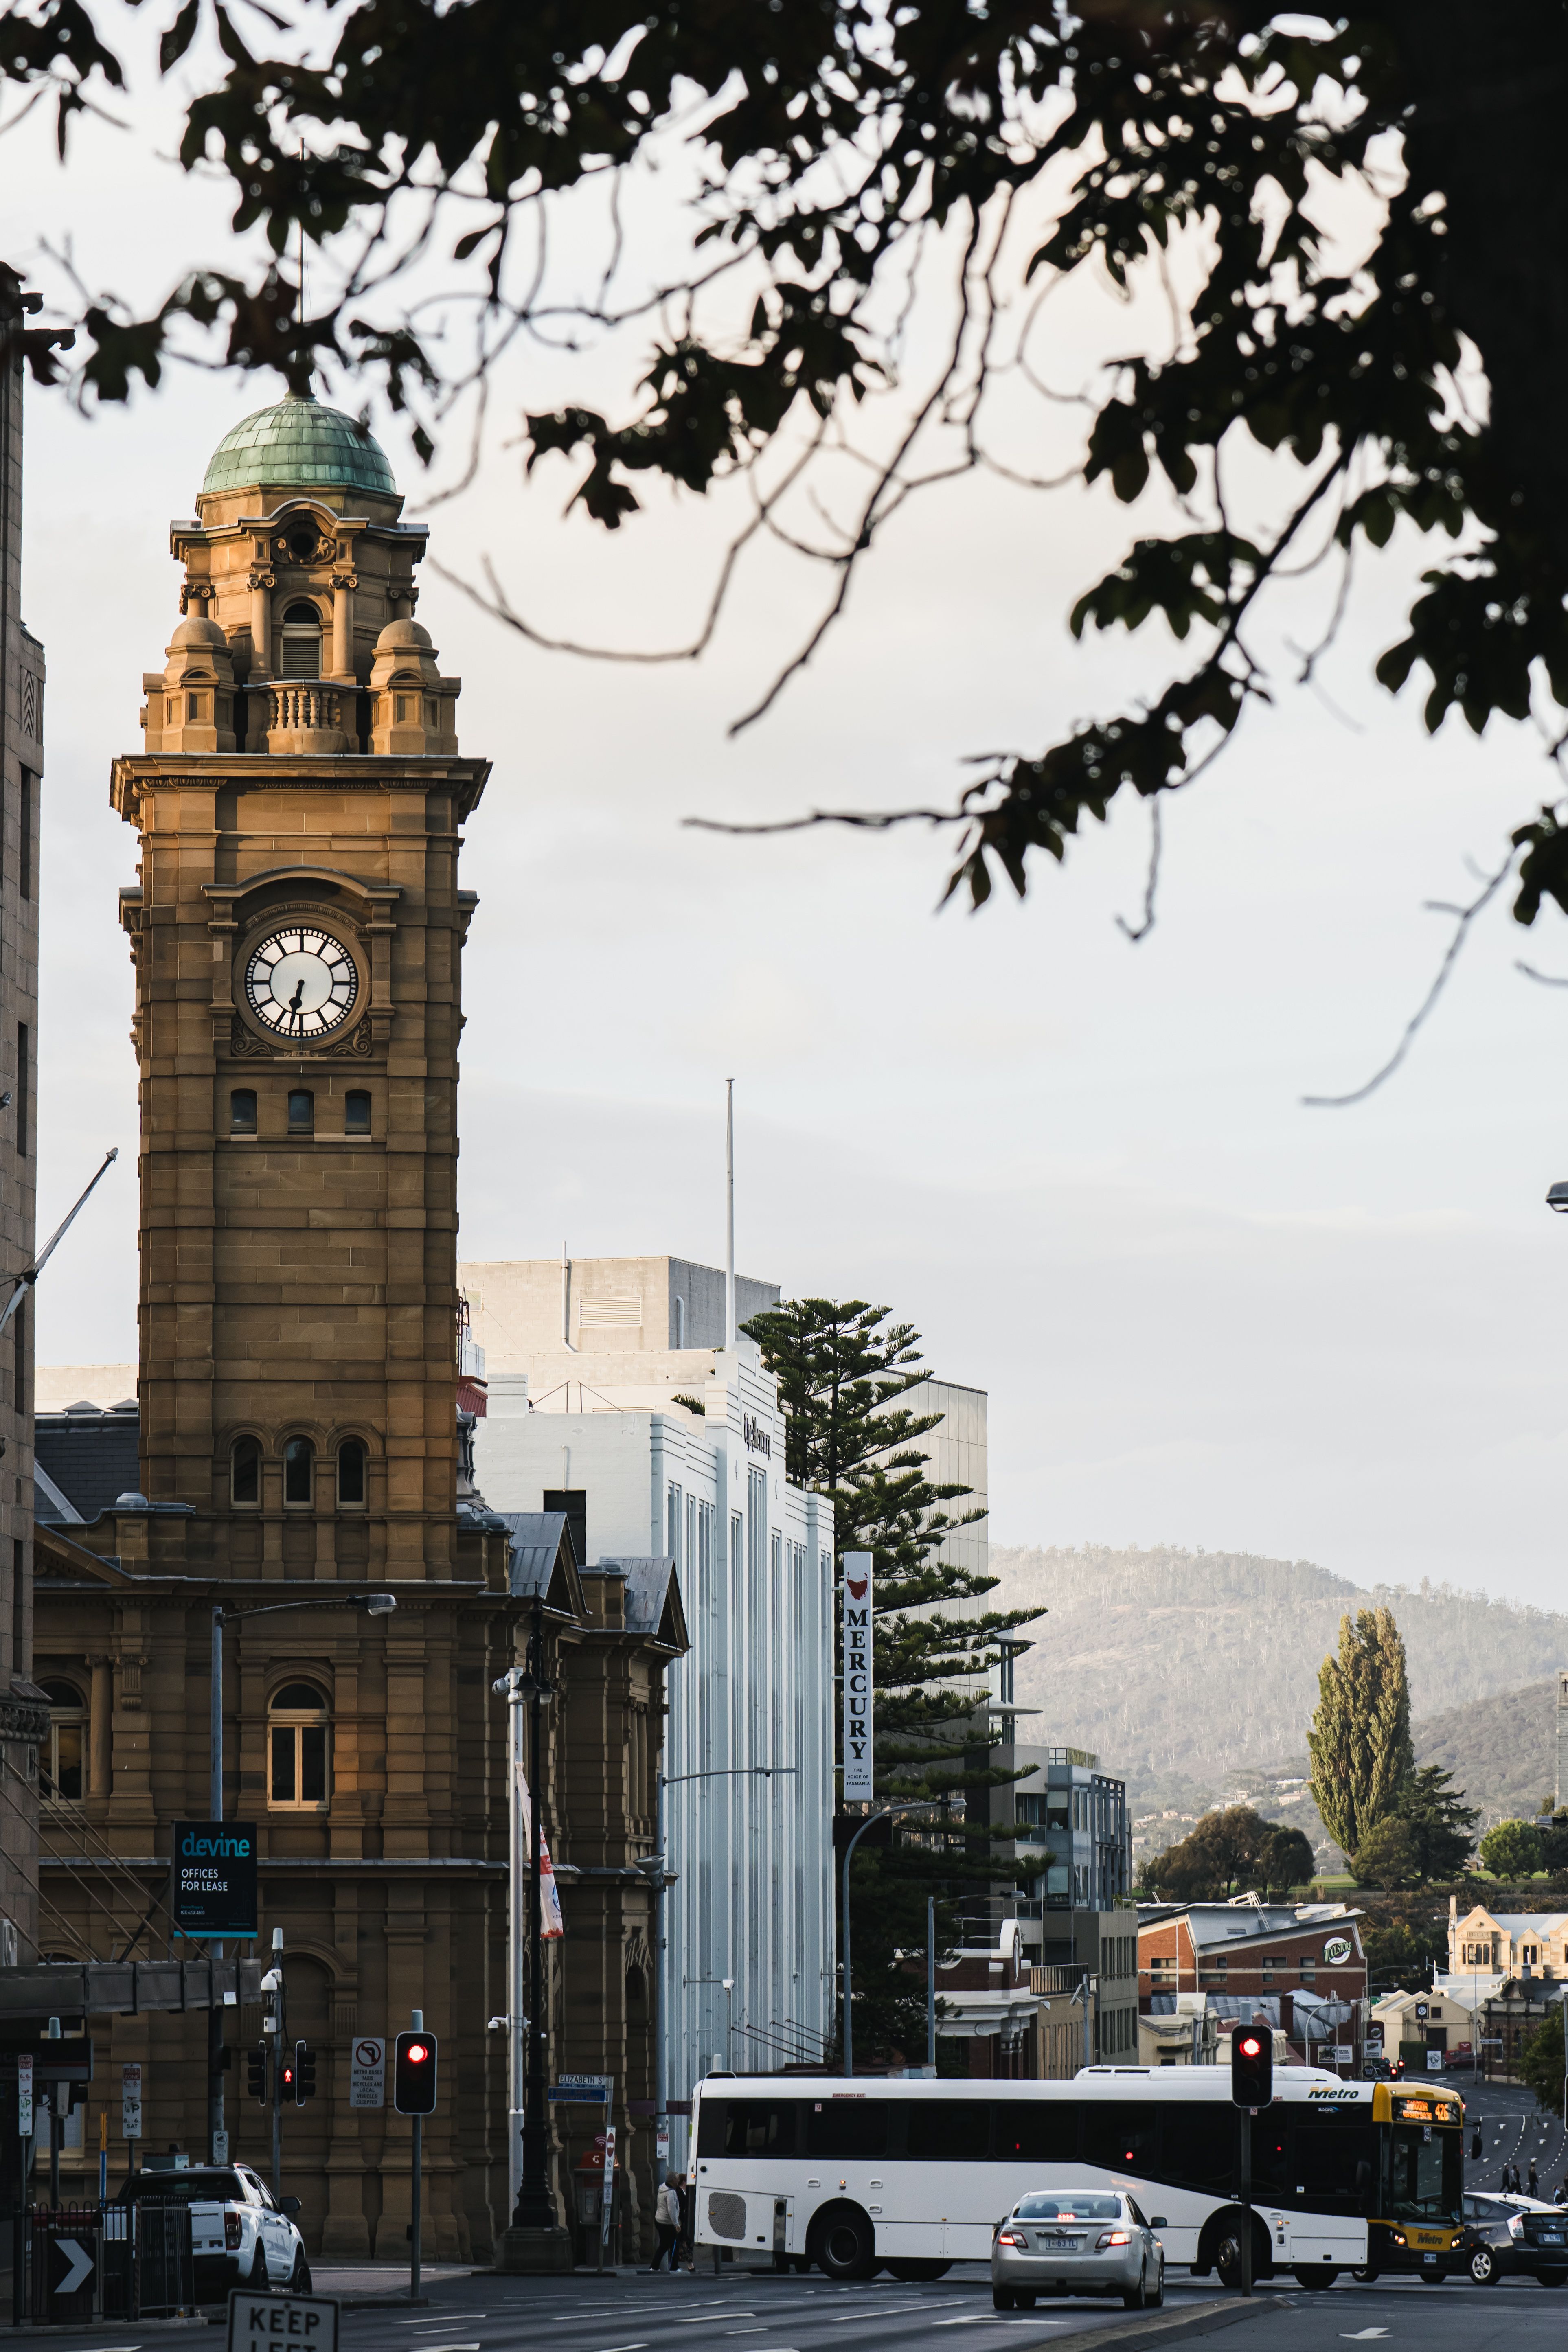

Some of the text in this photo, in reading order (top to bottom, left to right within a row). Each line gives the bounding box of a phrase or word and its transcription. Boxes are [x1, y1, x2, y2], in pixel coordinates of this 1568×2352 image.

[752, 1416, 771, 1461] Mercury
[847, 1609, 868, 1759] MERCURY
[182, 1832, 250, 1857] devine
[182, 1868, 218, 1878] OFFICES
[182, 1881, 228, 1891] FOR LEASE
[1324, 1942, 1351, 1962] WOOLSTORE
[1308, 2087, 1359, 2099] Metro
[1435, 2103, 1449, 2120] 426
[1418, 2232, 1443, 2244] Metro
[250, 2307, 320, 2335] KEEP
